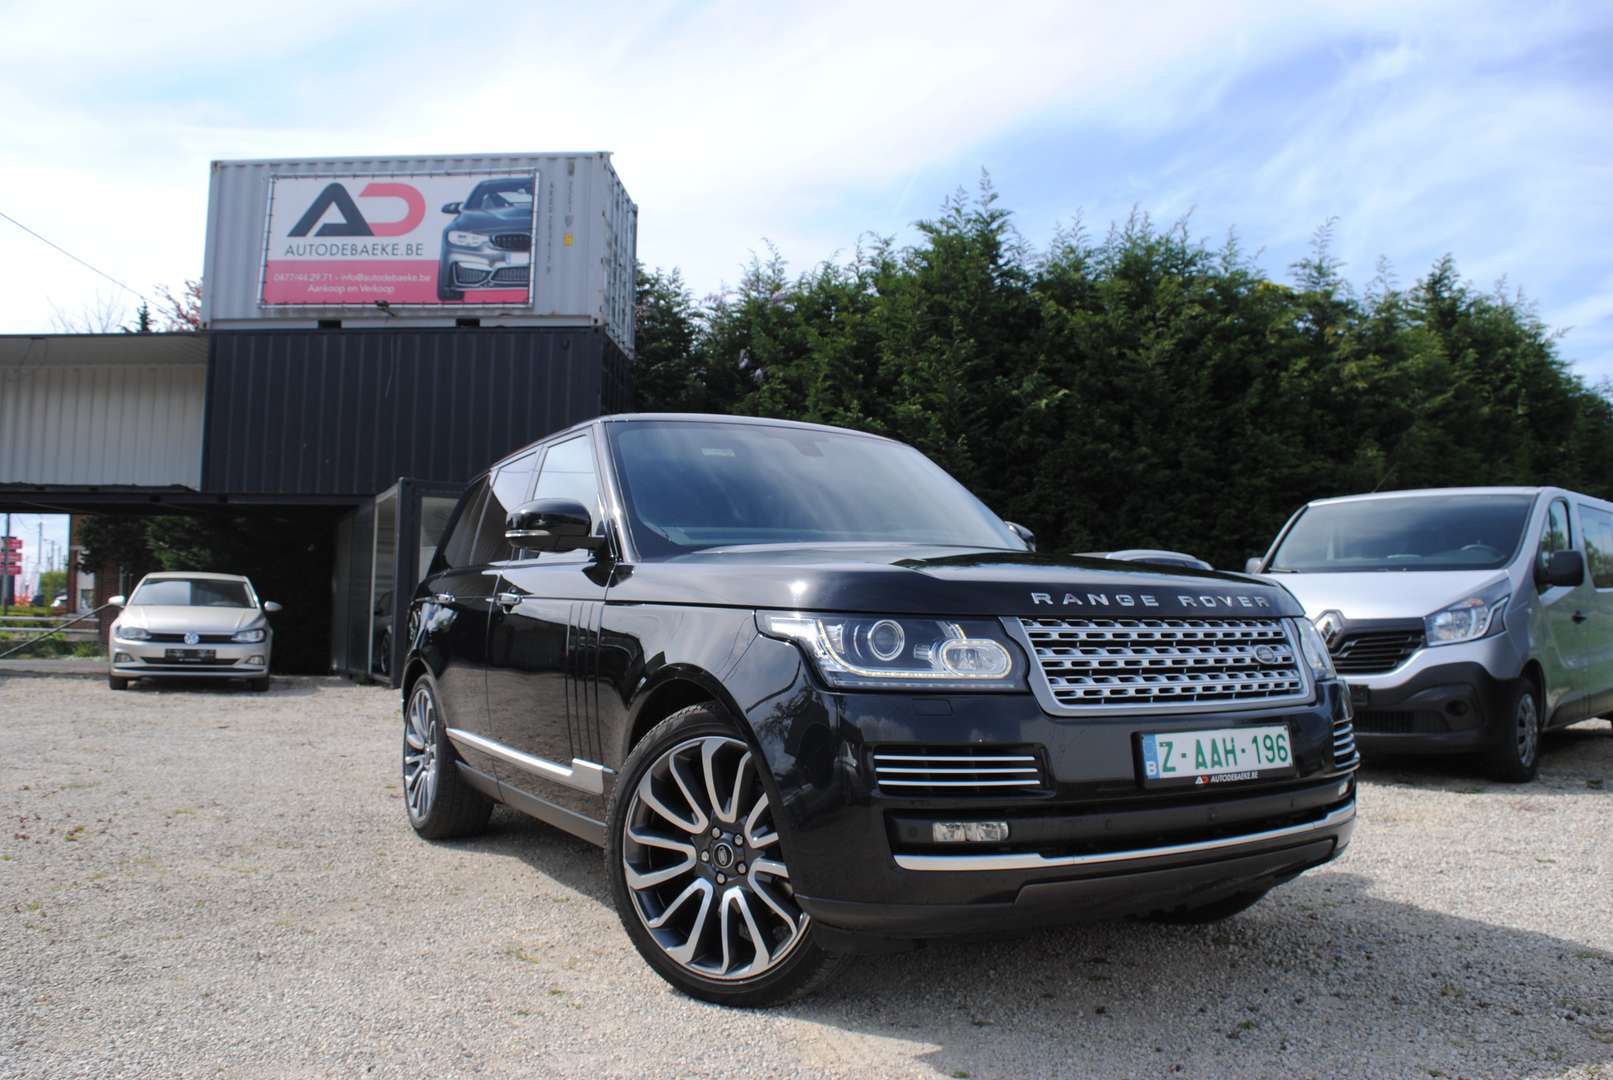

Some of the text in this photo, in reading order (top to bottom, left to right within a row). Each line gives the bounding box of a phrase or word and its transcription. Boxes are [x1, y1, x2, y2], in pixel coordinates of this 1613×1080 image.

[284, 242, 424, 257] AUTODEBAEKE.BE
[340, 271, 432, 283] info@autodebaeke.be
[307, 284, 345, 294] Aankoop
[359, 284, 395, 294] Verkoop
[1031, 591, 1270, 608] RANGE ROVER
[1145, 760, 1158, 776] B
[1211, 770, 1259, 783] AUTODEBAEKE.BE
